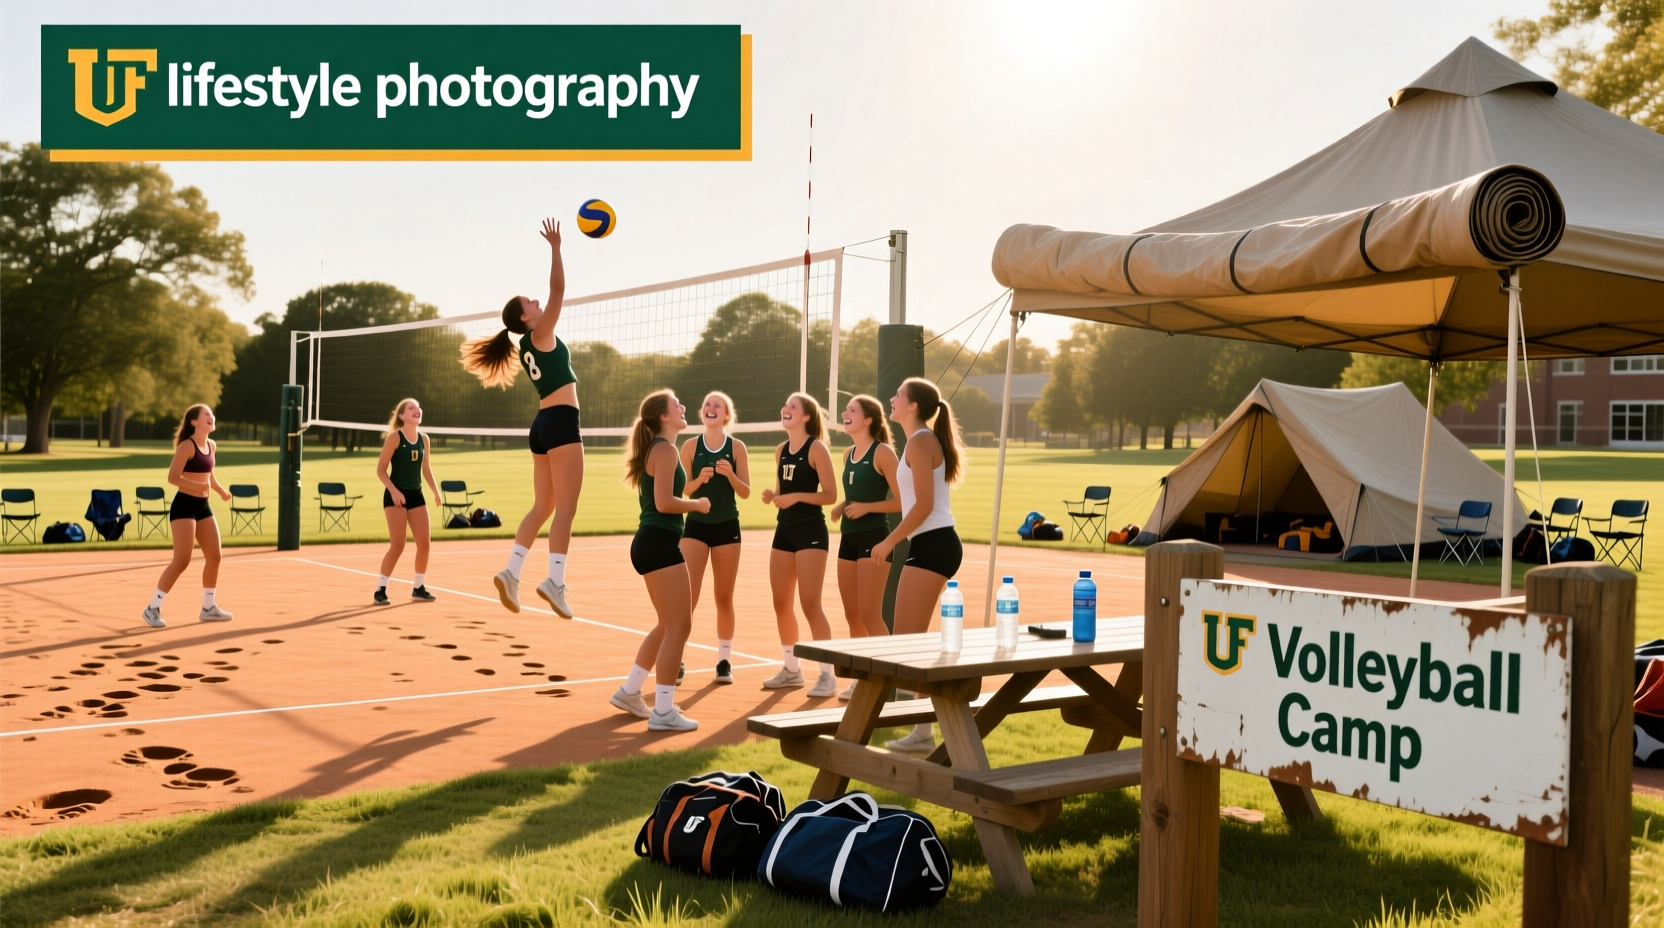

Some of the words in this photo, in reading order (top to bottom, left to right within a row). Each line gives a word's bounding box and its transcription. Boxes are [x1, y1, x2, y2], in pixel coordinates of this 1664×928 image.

[523, 351, 542, 381] 8
[1201, 610, 1257, 676] UF
[1268, 624, 1521, 715] Volleyball
[1278, 693, 1422, 783] Camp
